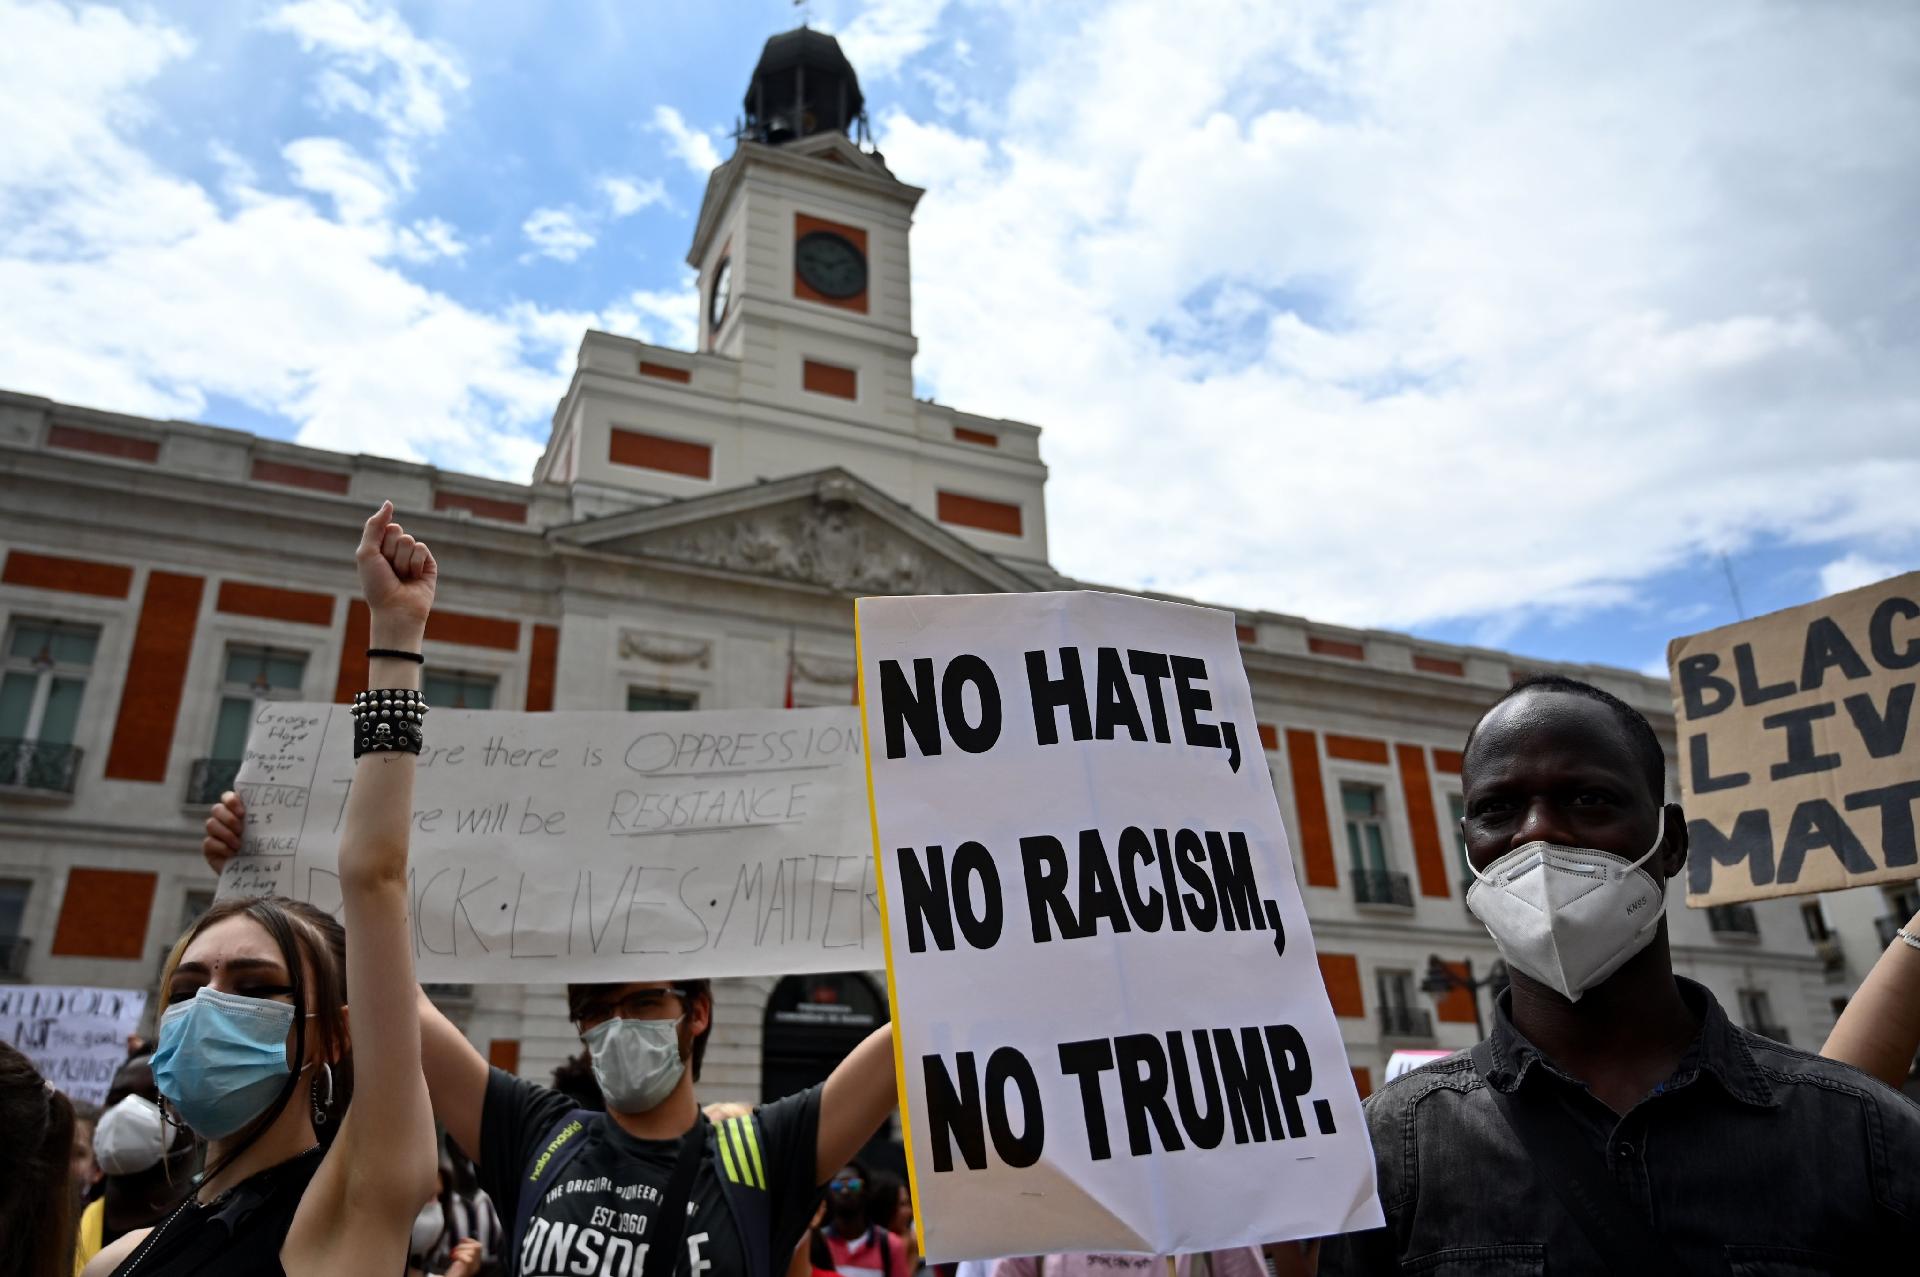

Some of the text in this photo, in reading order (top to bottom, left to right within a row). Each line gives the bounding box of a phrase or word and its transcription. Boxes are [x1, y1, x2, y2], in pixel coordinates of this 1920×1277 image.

[879, 646, 1241, 774] NO HATE,
[1678, 597, 1920, 721] BLAC
[483, 736, 558, 768] there
[583, 743, 603, 767] is
[624, 727, 861, 774] OPPRESSION
[1690, 683, 1916, 794] LIV
[333, 778, 812, 835] Tre will be RESISTANCE
[1686, 780, 1920, 894] MAT
[511, 865, 710, 959] LIVES
[714, 854, 880, 950] MATTER
[897, 826, 1285, 957] NO RACISM,
[922, 1024, 1337, 1173] NO TRUMP.
